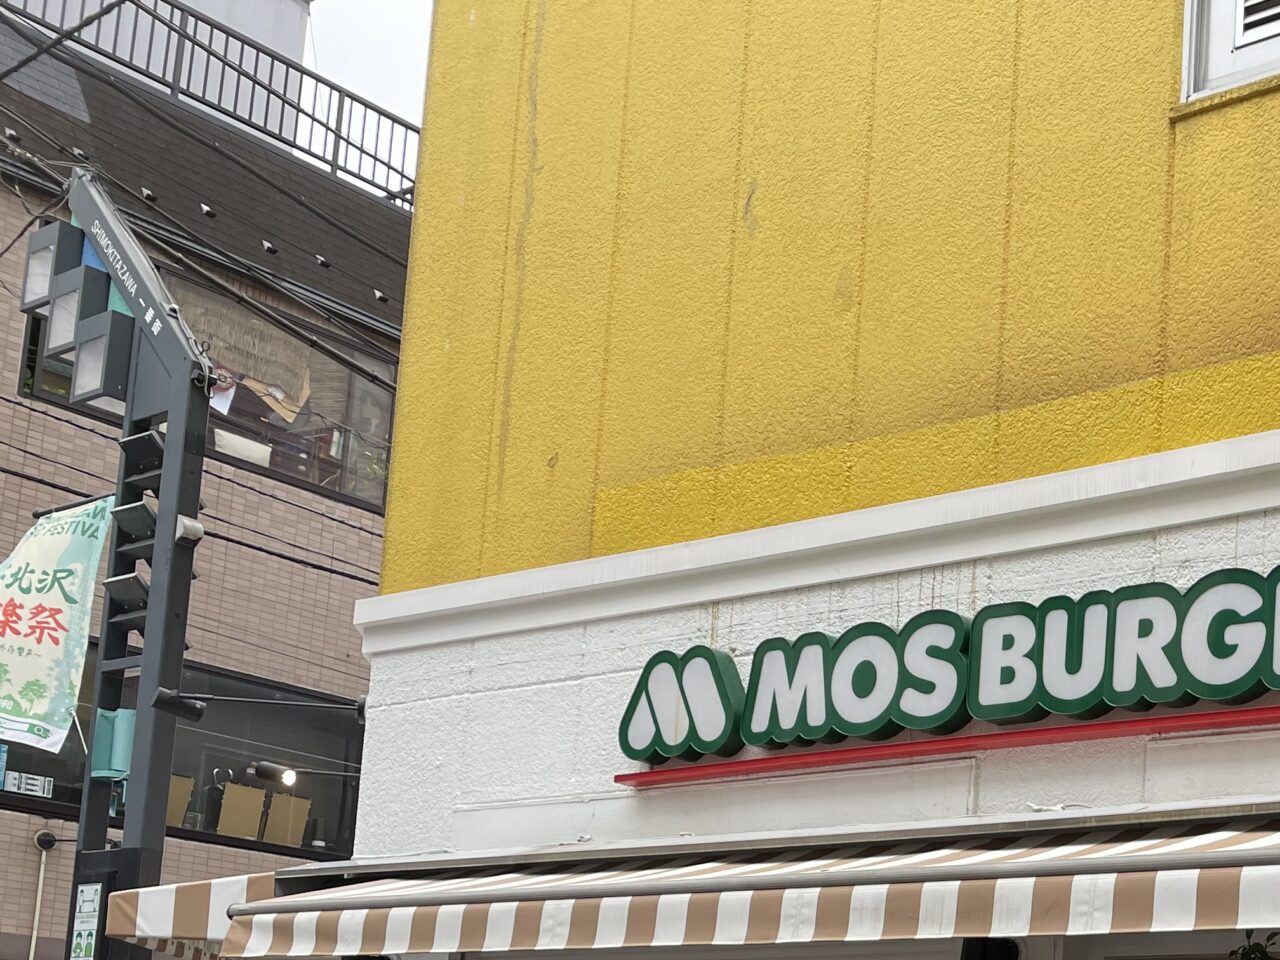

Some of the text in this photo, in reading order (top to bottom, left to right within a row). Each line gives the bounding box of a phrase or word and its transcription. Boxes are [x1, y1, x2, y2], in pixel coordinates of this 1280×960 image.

[91, 220, 138, 297] SHIMOKITAZAWA
[0, 562, 79, 604] 北沢
[750, 623, 958, 735] MOS
